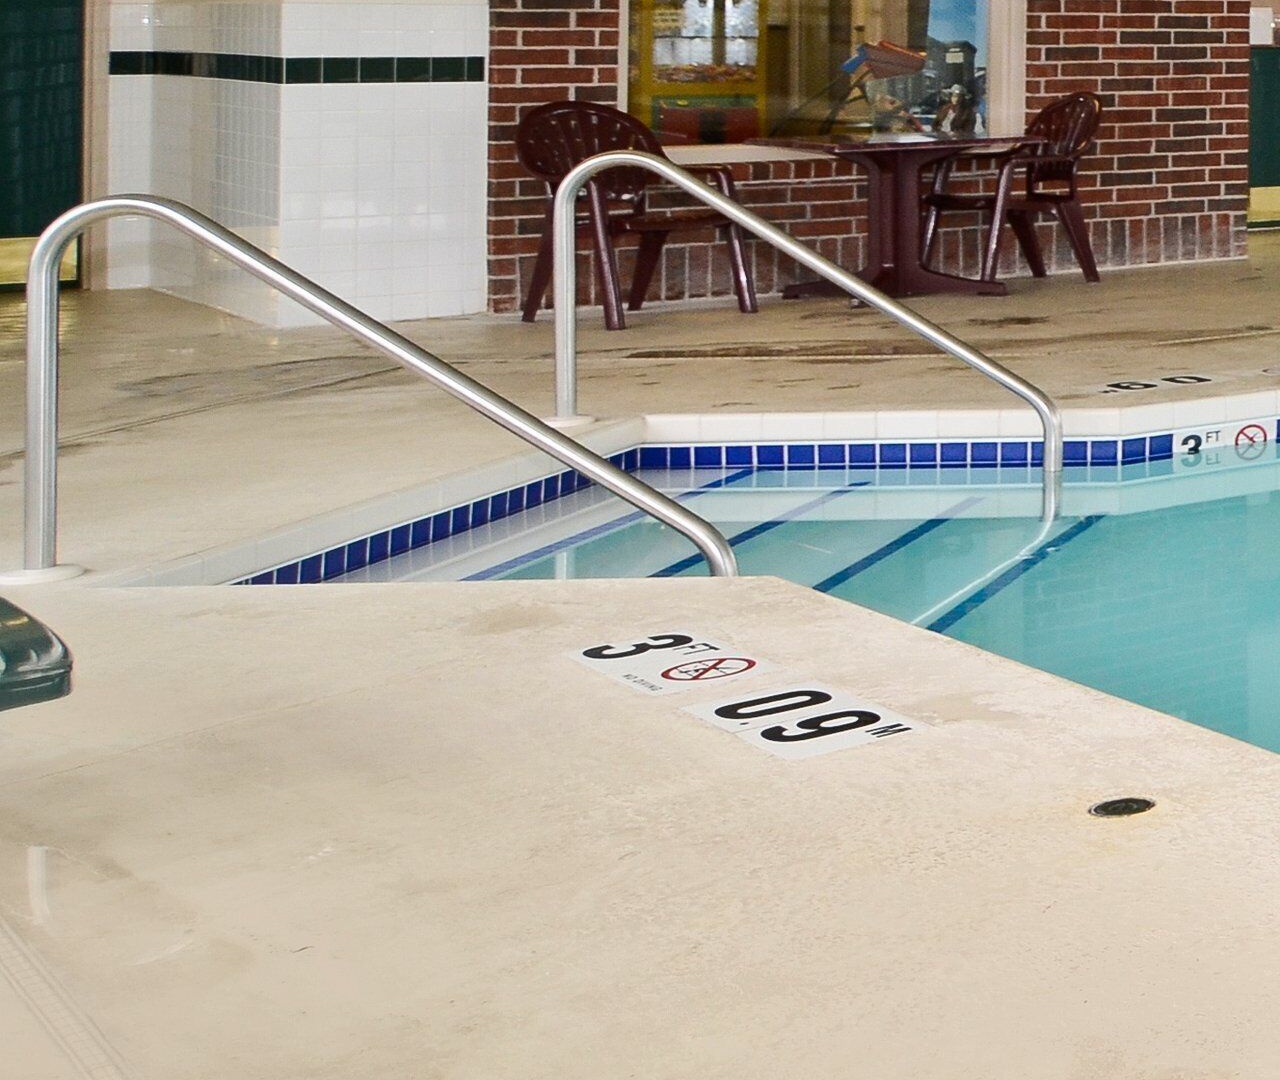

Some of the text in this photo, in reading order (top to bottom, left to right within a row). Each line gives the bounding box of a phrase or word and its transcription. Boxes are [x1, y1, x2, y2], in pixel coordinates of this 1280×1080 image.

[1181, 434, 1202, 455] 3
[1205, 430, 1221, 443] FT
[583, 634, 721, 659] 3 FT
